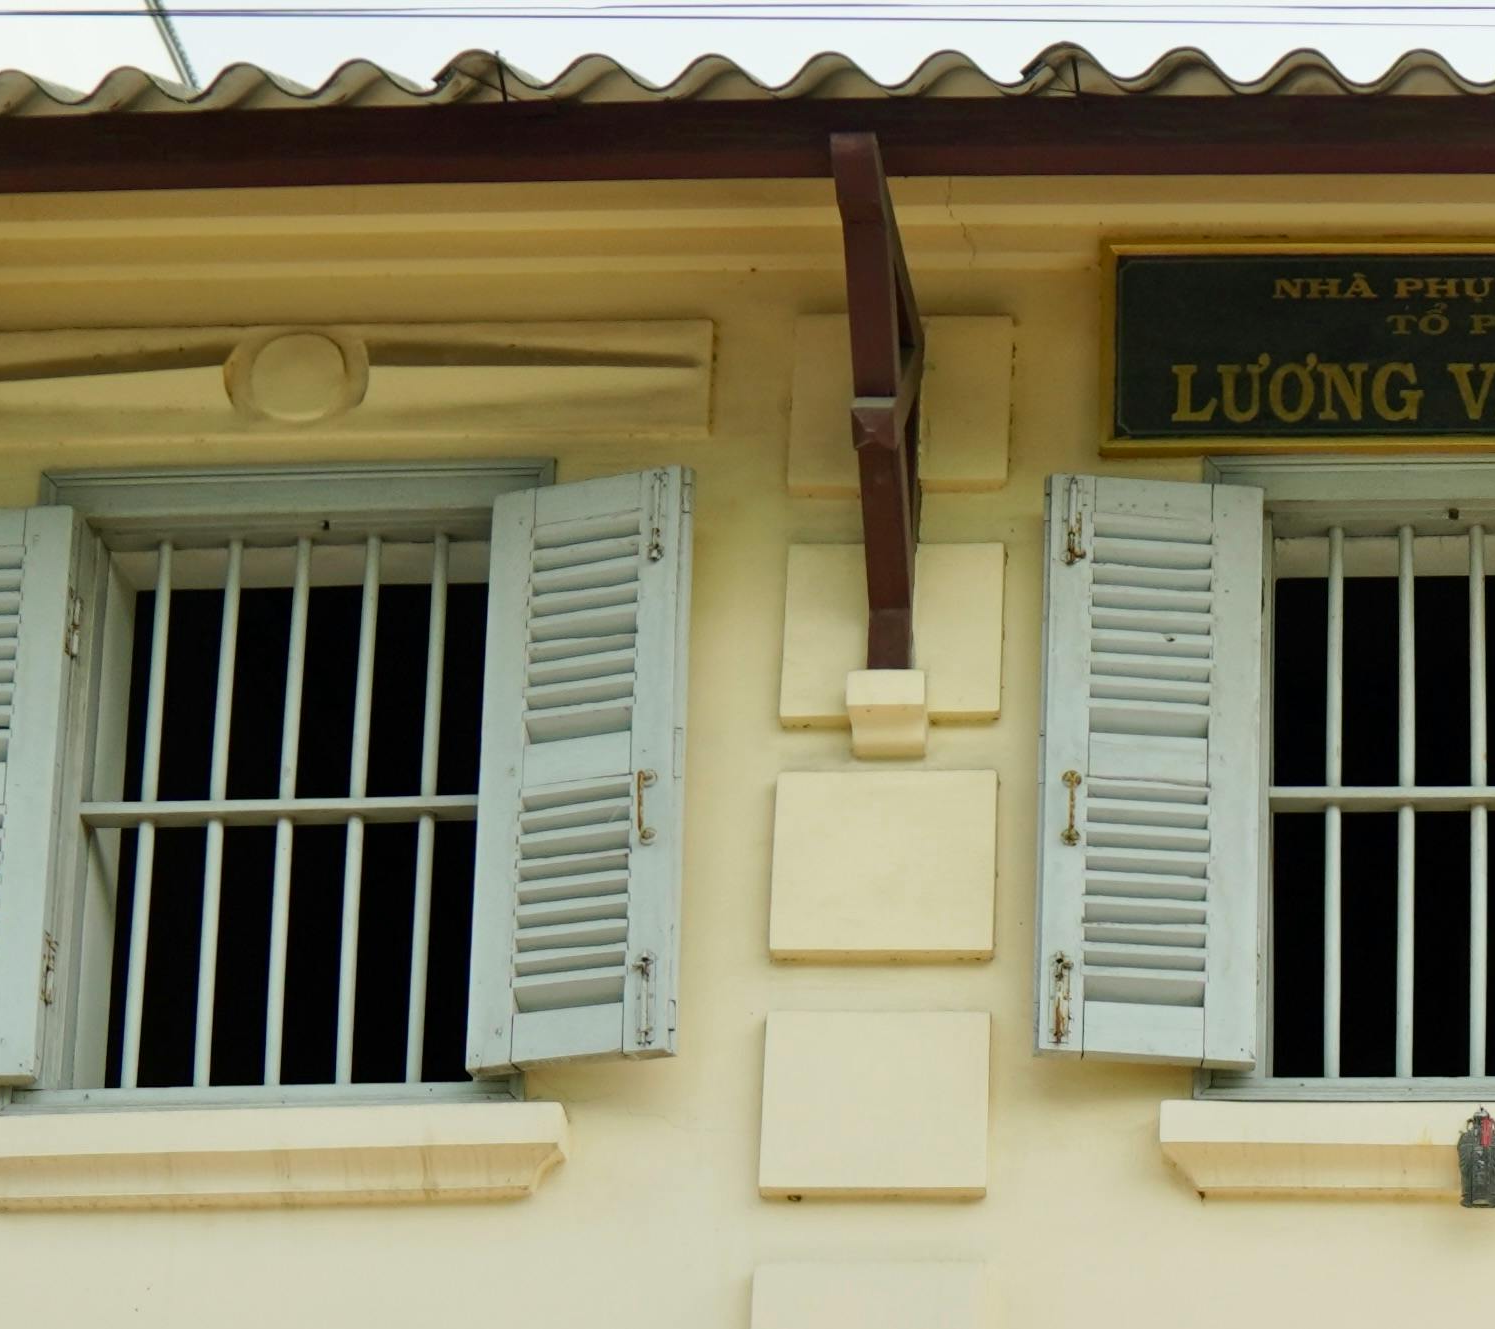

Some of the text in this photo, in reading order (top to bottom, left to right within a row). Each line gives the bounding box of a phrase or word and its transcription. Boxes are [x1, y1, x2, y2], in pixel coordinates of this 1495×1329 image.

[1273, 272, 1379, 299] NHÀ
[1387, 303, 1448, 336] TỔ
[1170, 354, 1424, 423] LƯƠNG
